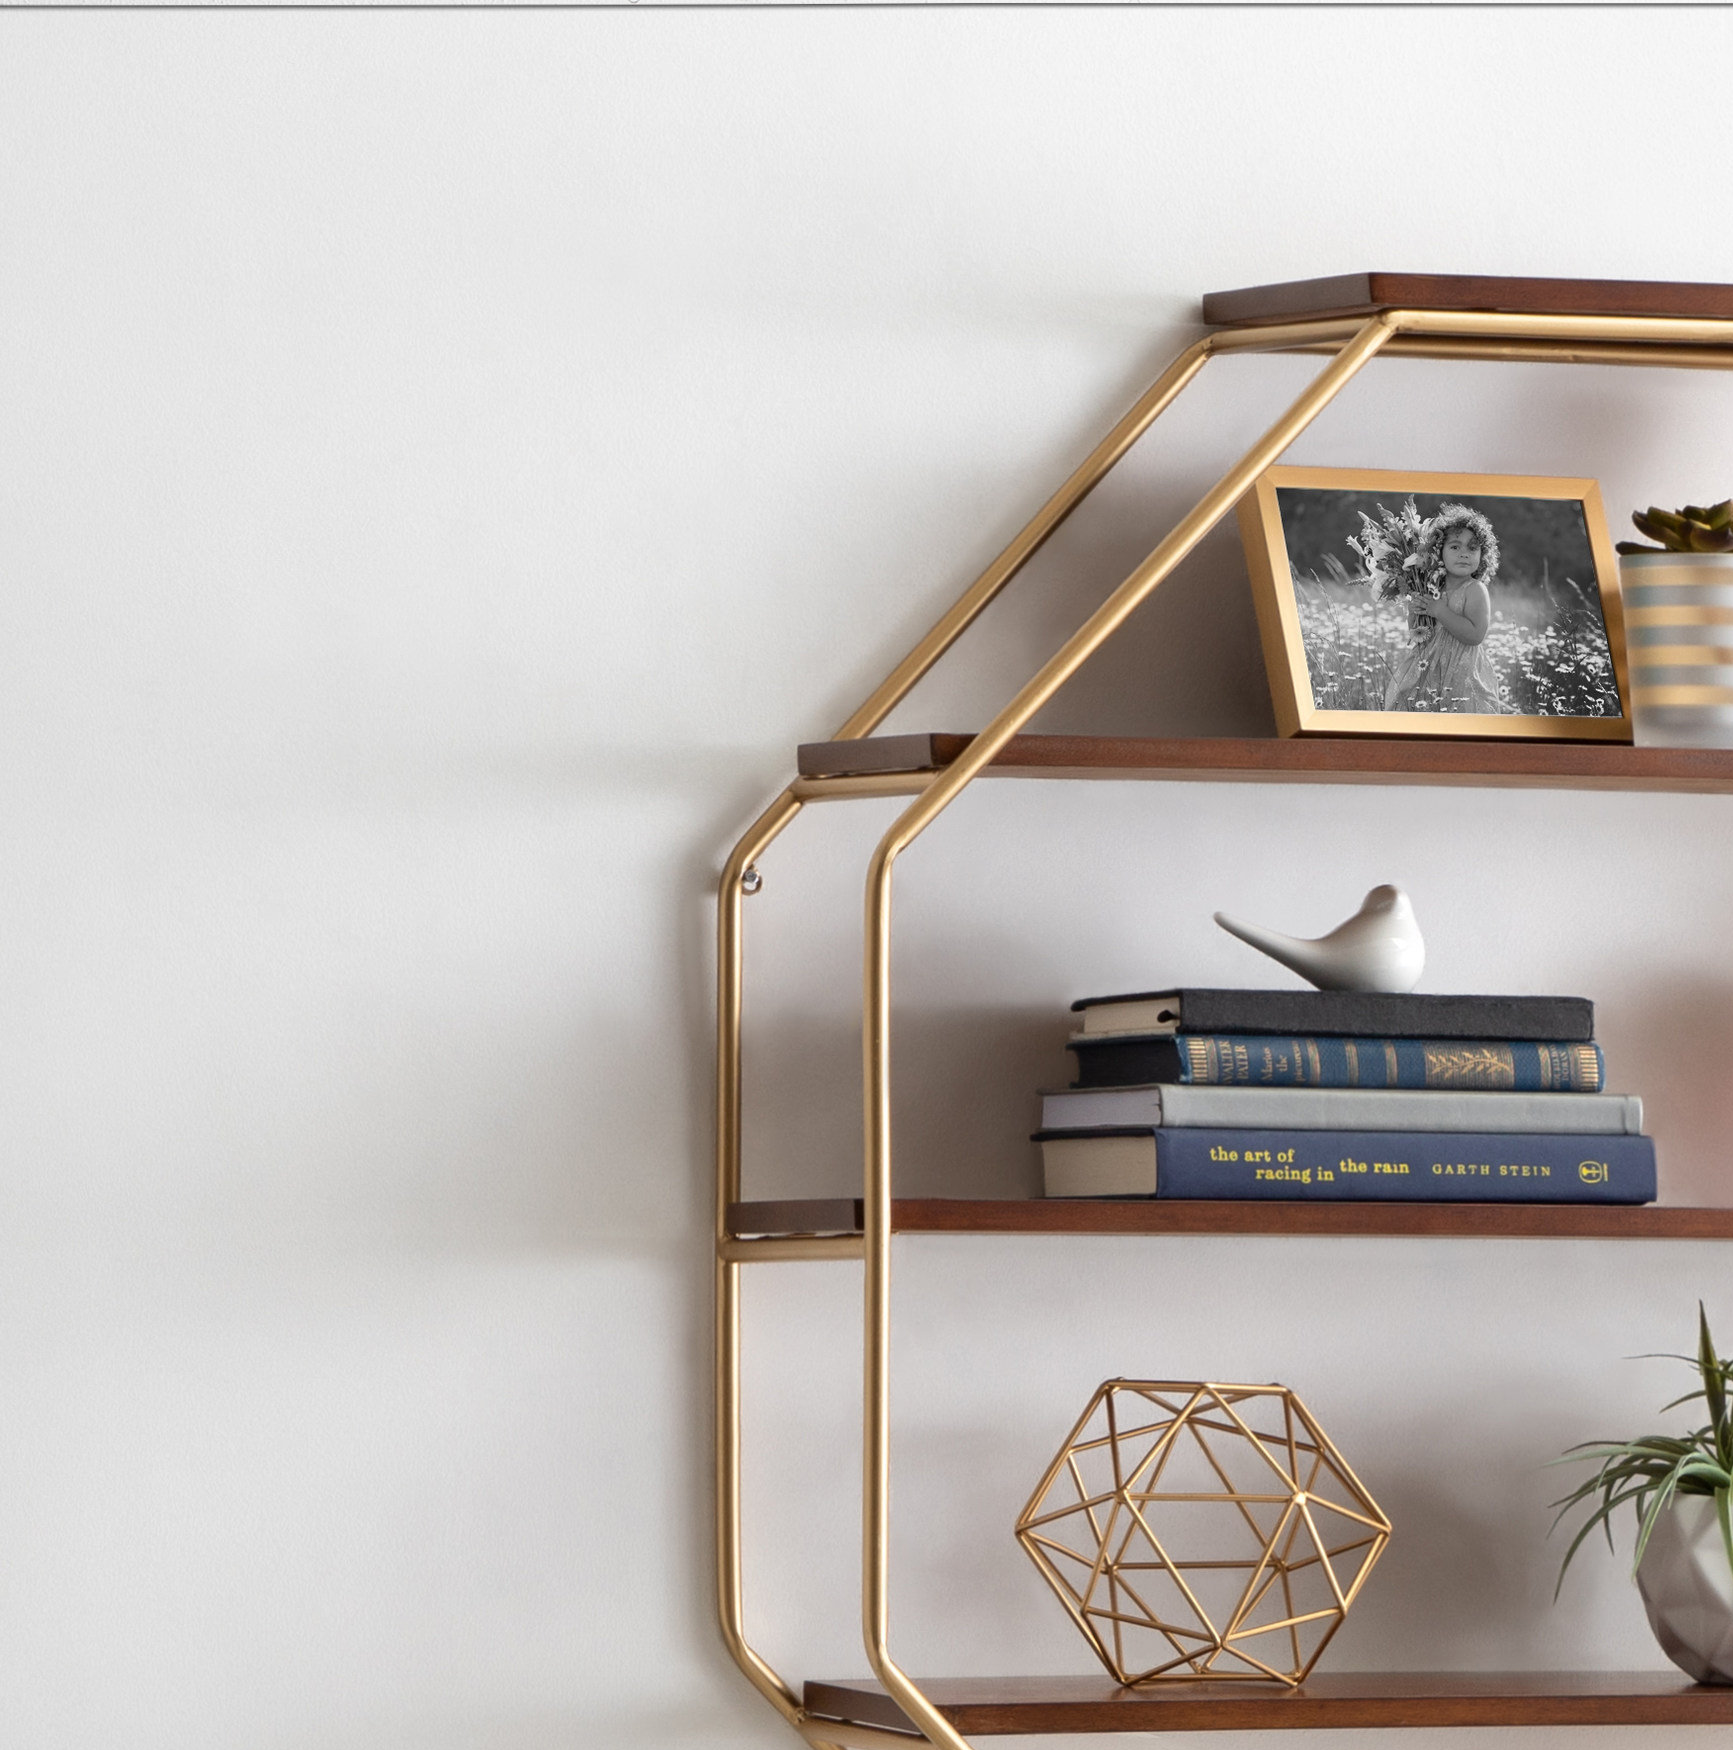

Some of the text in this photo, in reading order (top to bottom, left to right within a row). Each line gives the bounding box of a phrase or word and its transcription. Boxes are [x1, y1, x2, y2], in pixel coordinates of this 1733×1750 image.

[1219, 1041, 1233, 1085] WALTER
[1235, 1046, 1248, 1079] PATER
[1275, 1055, 1289, 1072] the
[1210, 1146, 1295, 1163] the art of
[1256, 1158, 1410, 1184] racing in the rain
[1432, 1163, 1551, 1177] GARTH STEIN
